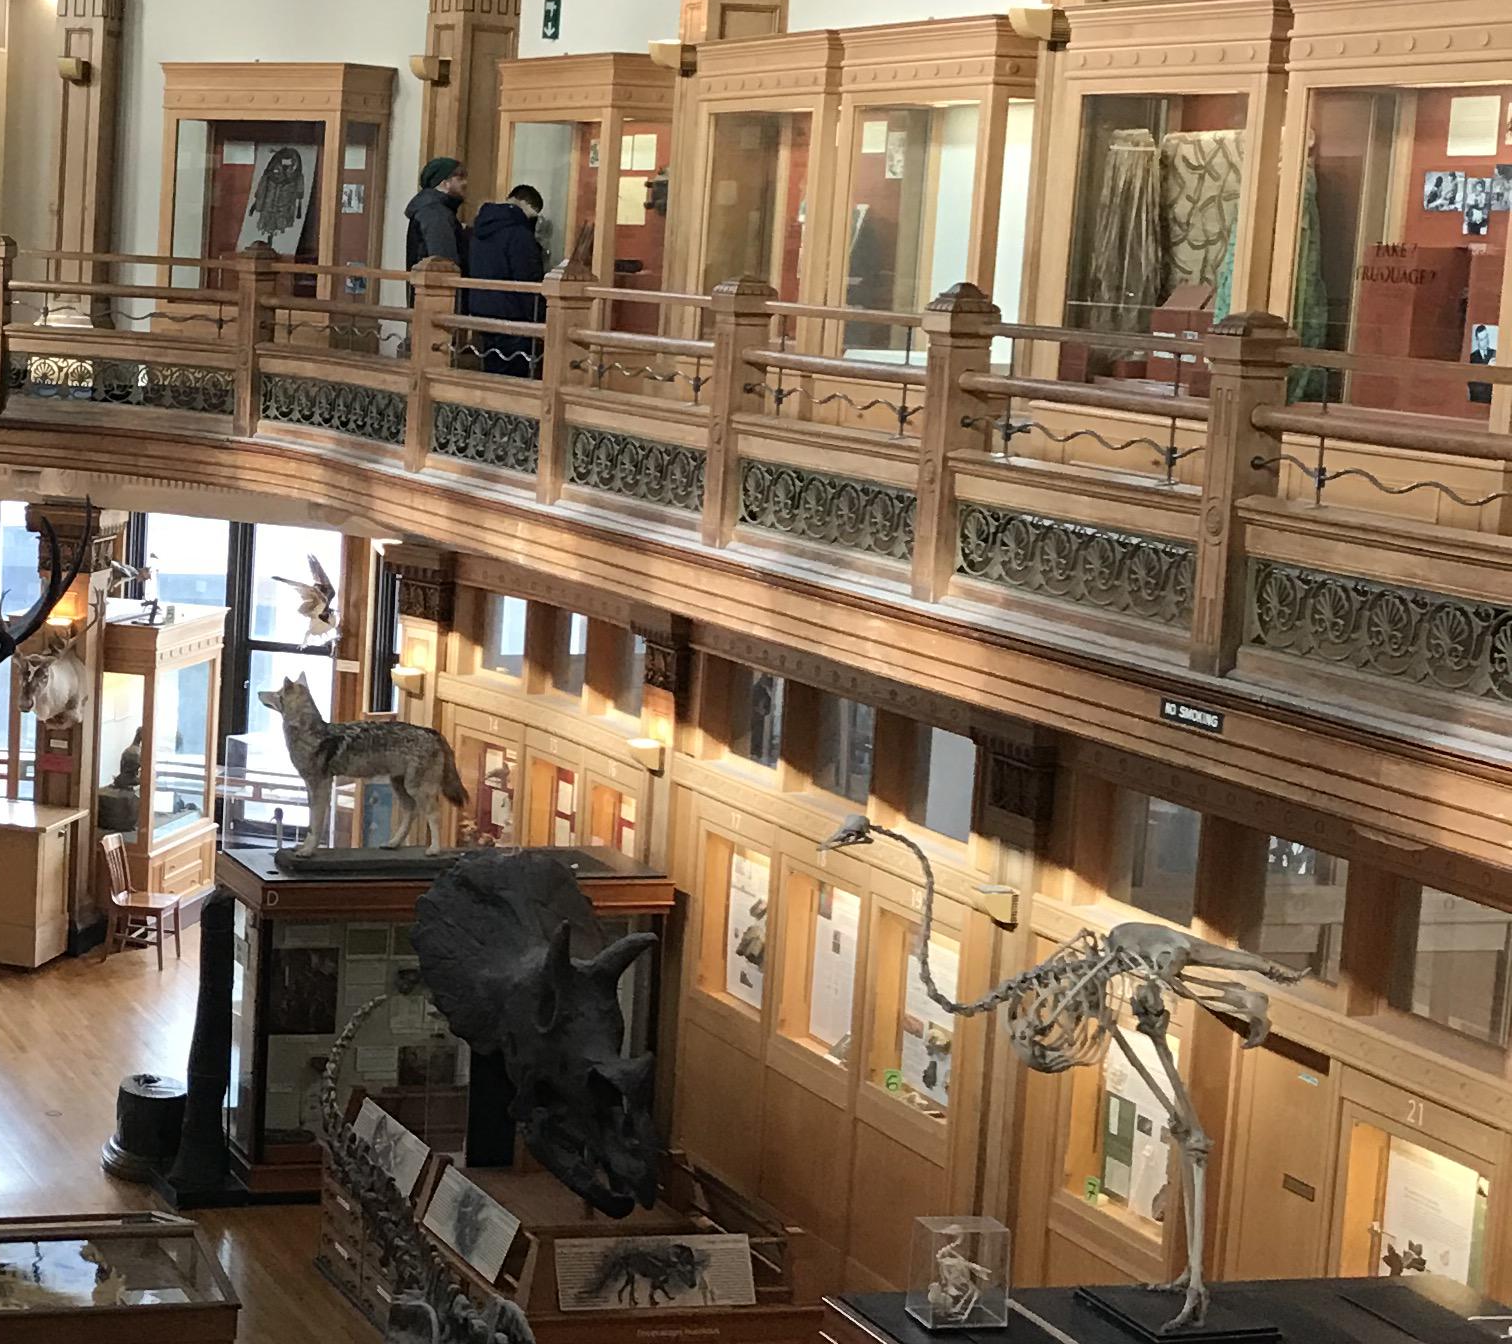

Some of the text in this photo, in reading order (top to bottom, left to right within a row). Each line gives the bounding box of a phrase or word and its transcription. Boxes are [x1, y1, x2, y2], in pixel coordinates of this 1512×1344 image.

[1164, 702, 1219, 728] NO SMOKING
[266, 890, 279, 906] D
[886, 1074, 897, 1091] 6
[1407, 1099, 1423, 1126] 21
